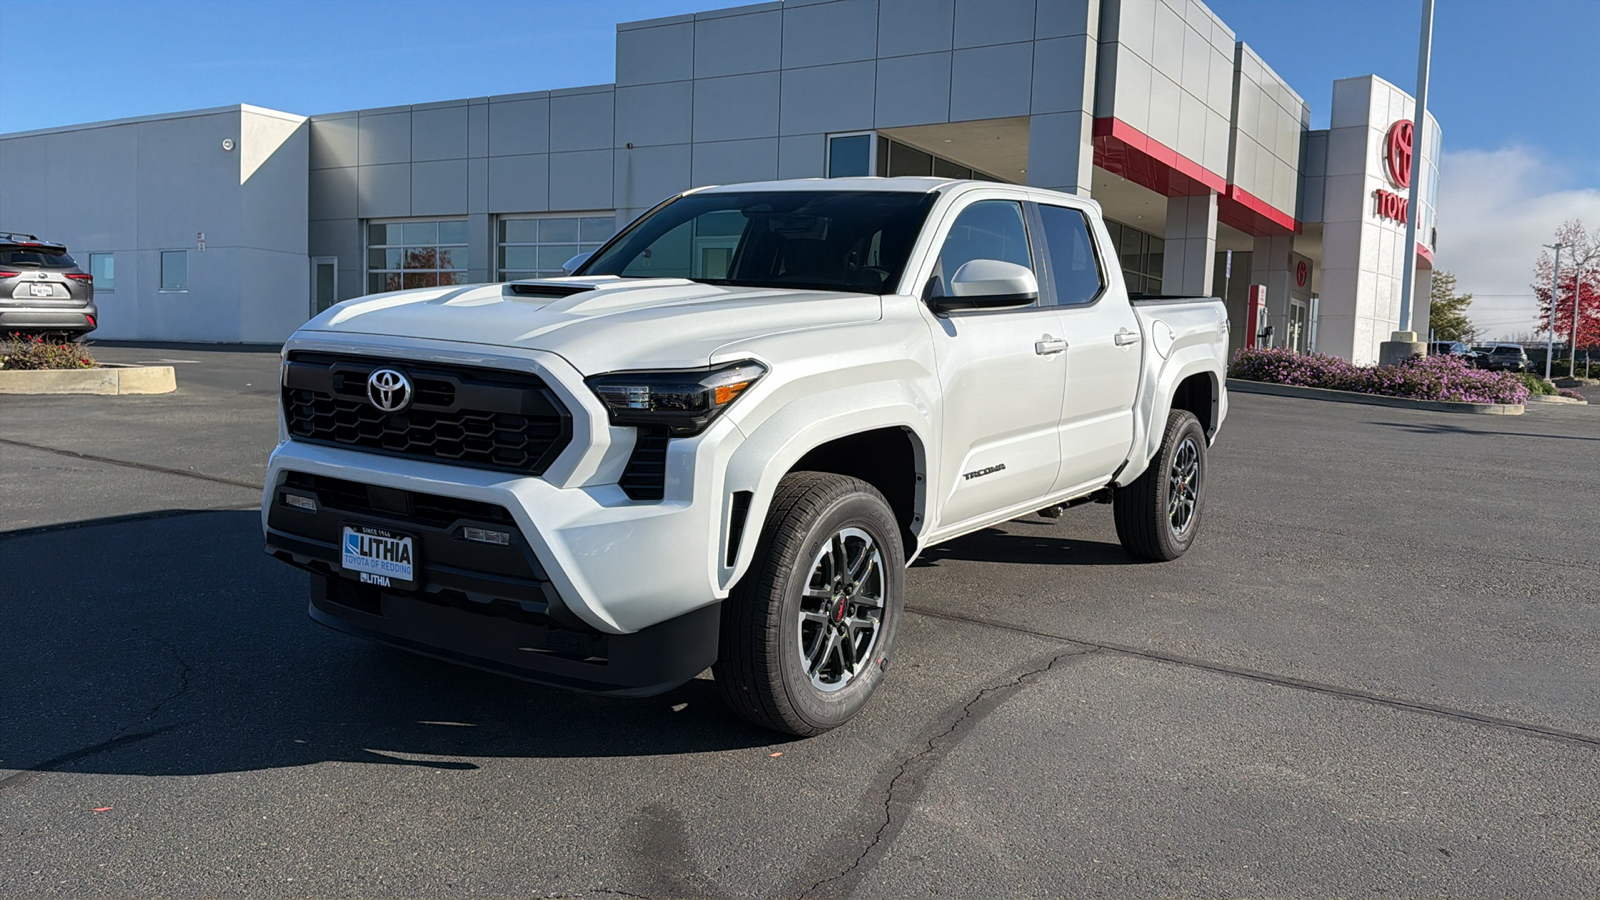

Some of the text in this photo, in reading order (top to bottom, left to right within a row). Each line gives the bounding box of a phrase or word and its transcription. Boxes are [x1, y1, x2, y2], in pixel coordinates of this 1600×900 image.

[1375, 189, 1409, 224] TOY
[962, 463, 1006, 480] TACOMA
[362, 527, 391, 538] SINCE 1946
[360, 536, 411, 565] LITHIA
[344, 554, 412, 575] TOYOTA OF REDDING
[367, 573, 391, 587] LITHIA
